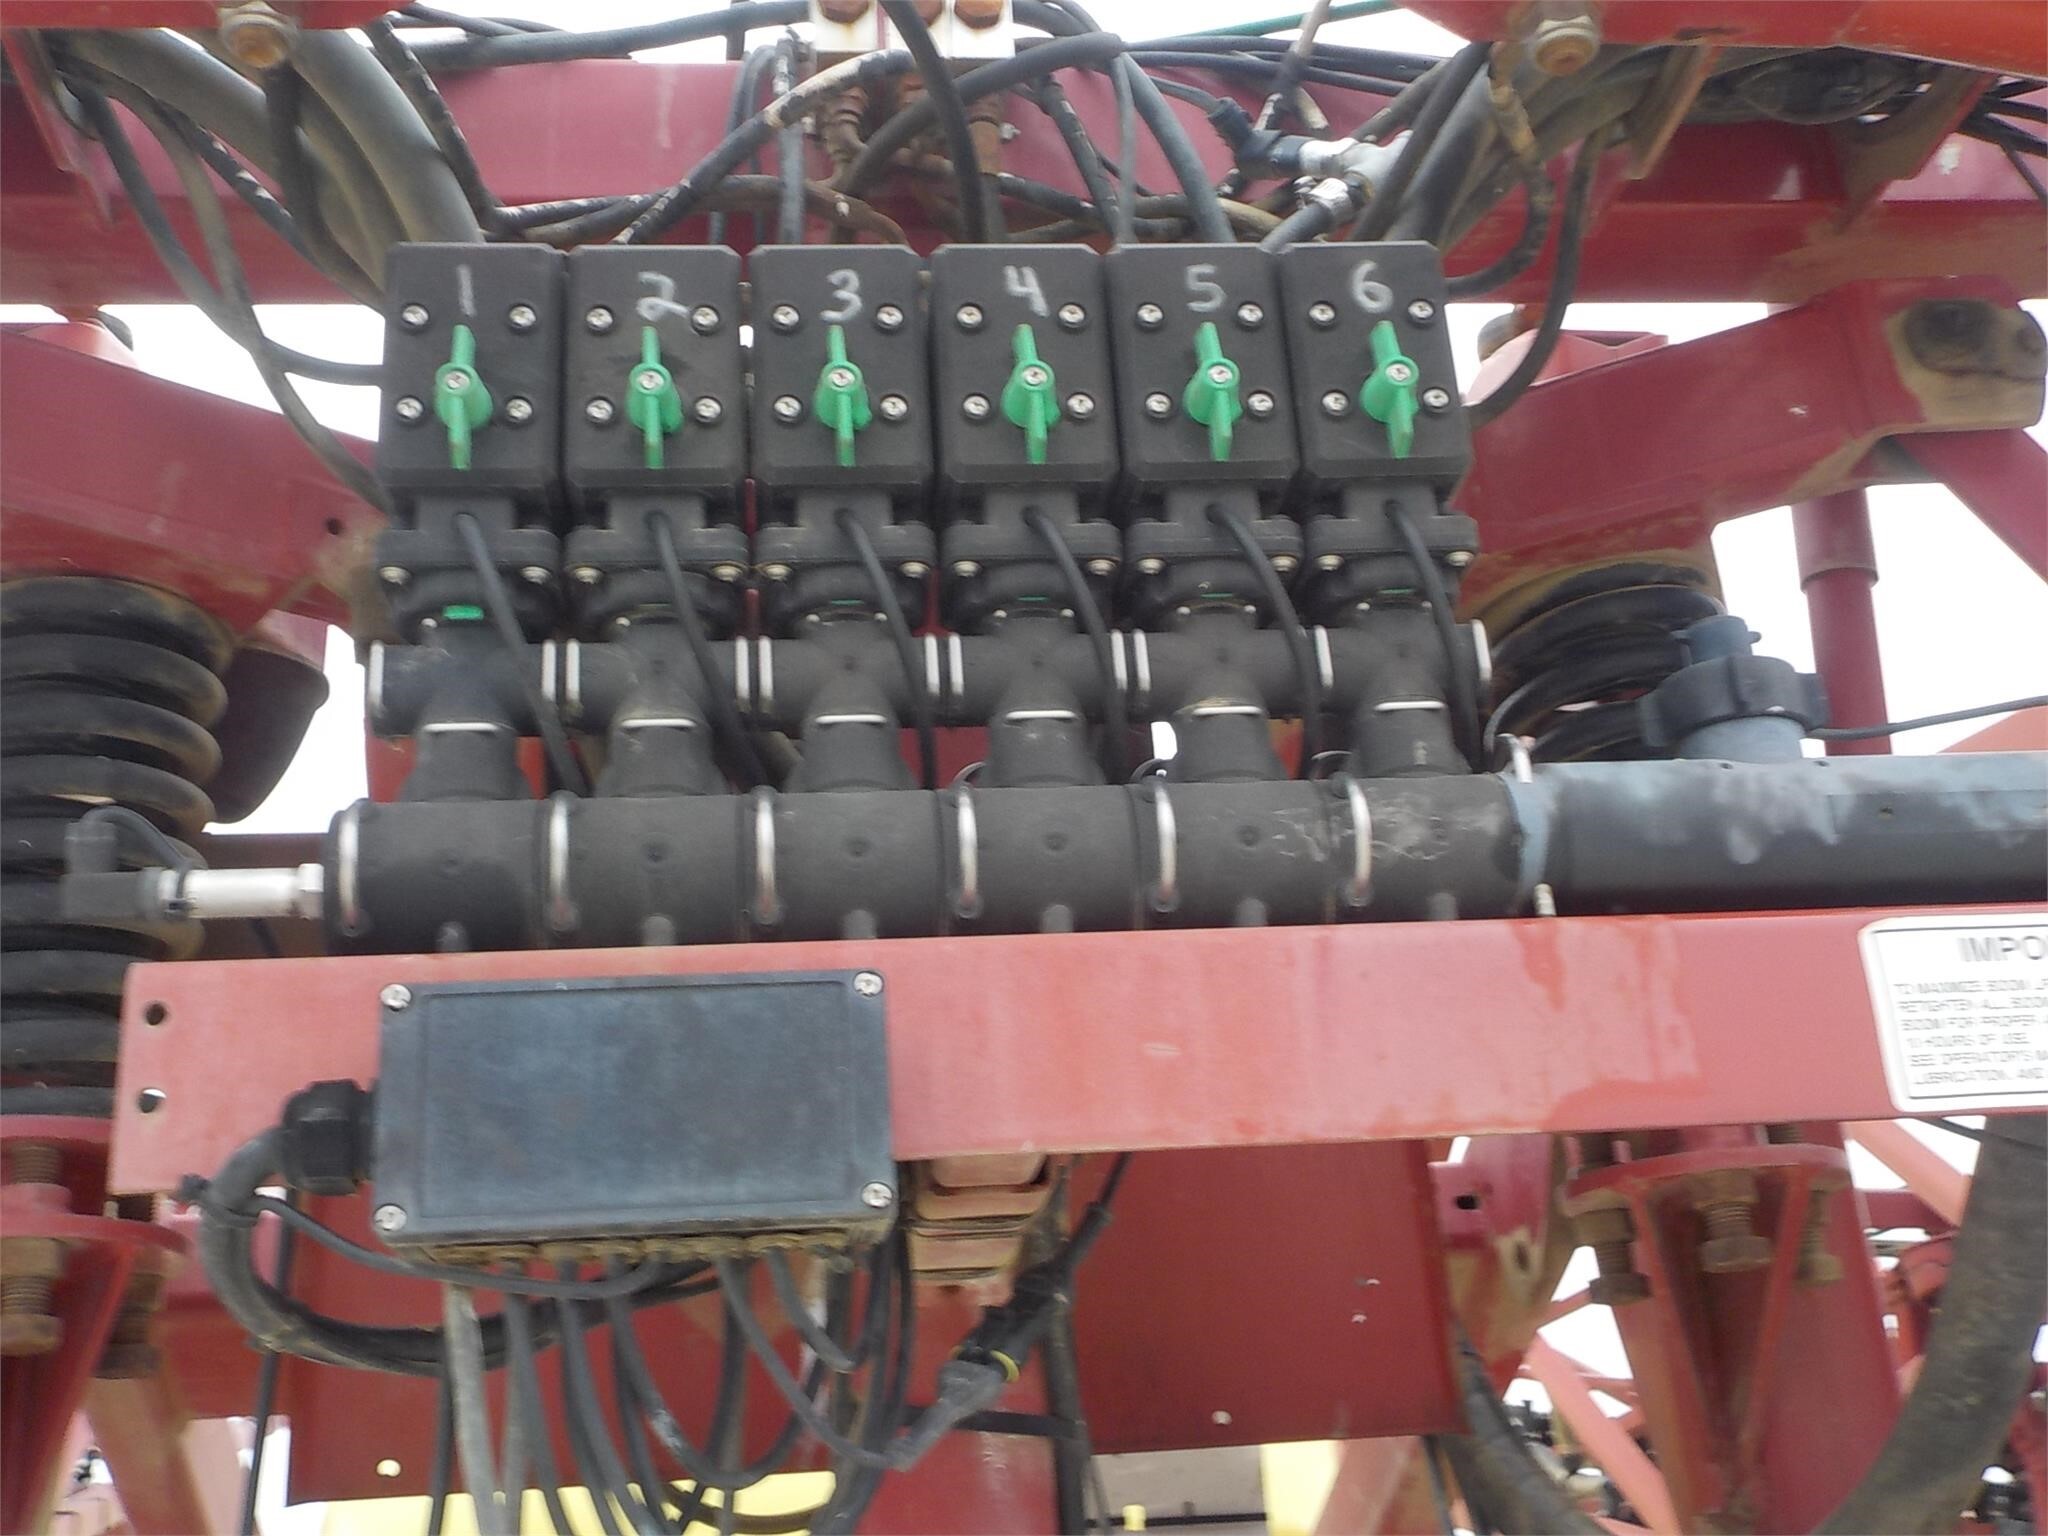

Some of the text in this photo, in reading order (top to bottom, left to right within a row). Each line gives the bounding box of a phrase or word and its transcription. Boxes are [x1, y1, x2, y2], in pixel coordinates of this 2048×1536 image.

[458, 264, 477, 318] 1
[636, 271, 691, 322] 2
[821, 268, 864, 323] 3
[1003, 265, 1050, 318] 4
[1185, 263, 1228, 313] 5
[1351, 260, 1395, 314] 6
[1957, 936, 2048, 962] IMPO
